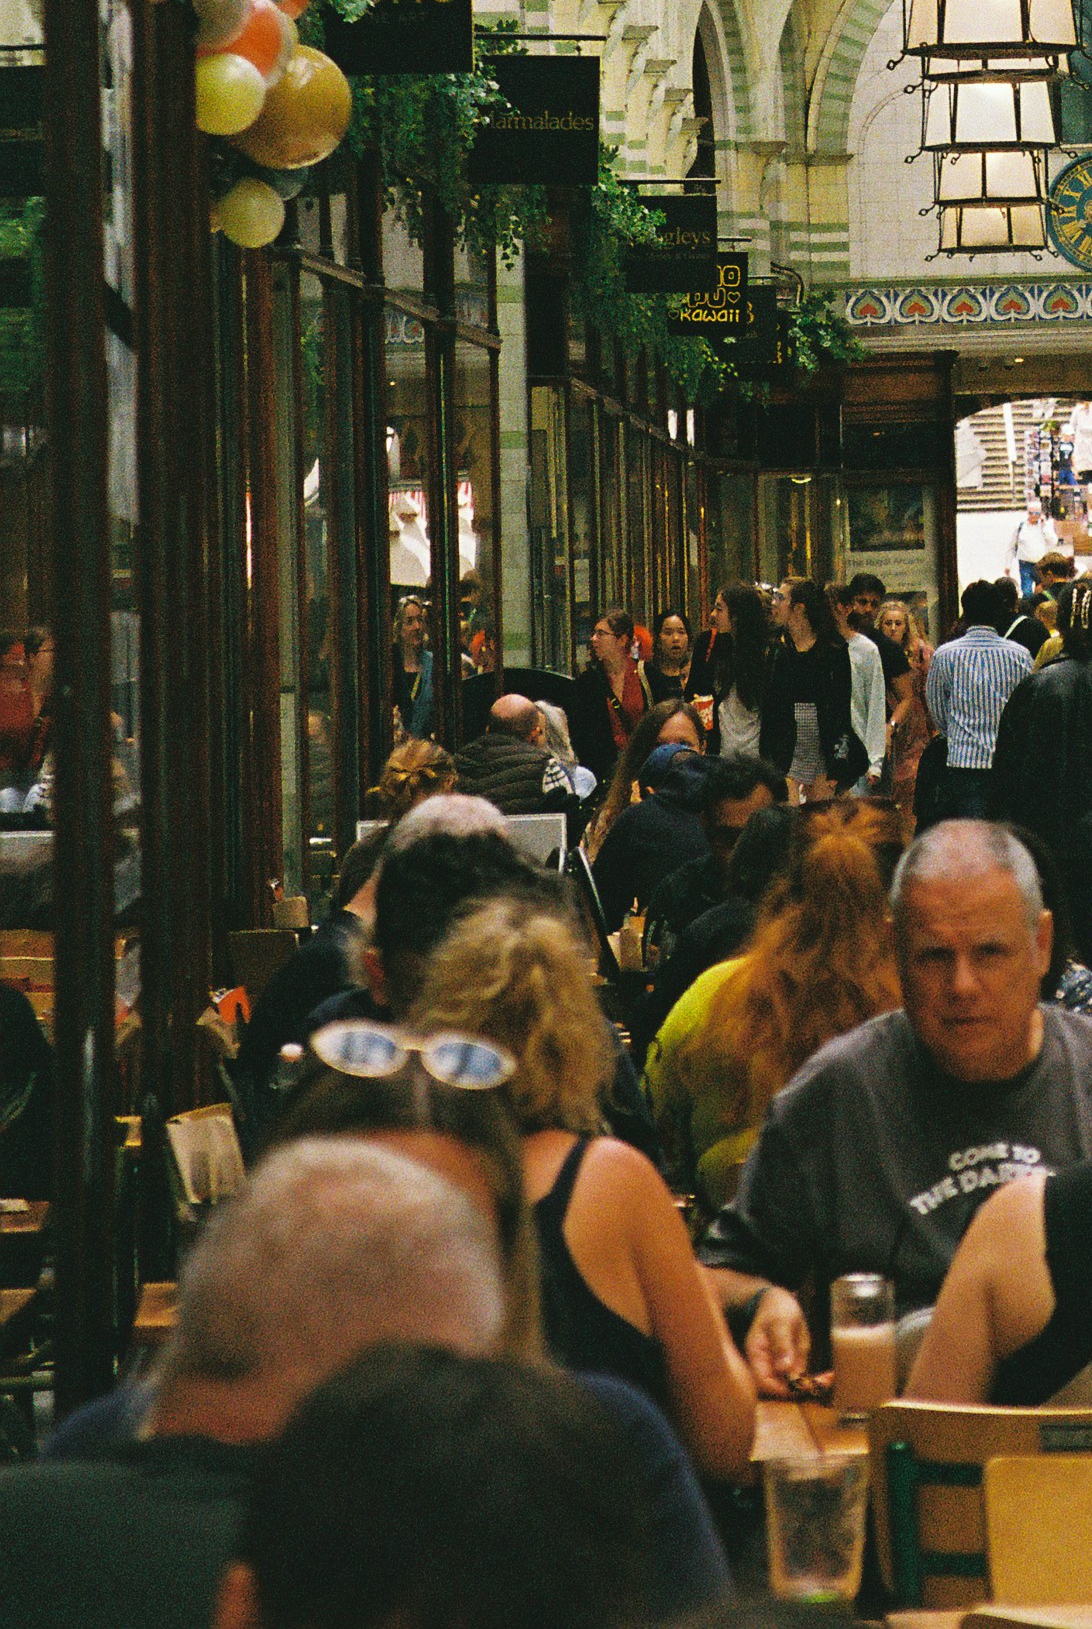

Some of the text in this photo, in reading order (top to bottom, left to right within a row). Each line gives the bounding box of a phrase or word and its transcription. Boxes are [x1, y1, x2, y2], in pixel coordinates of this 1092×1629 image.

[660, 227, 711, 249] gleys
[949, 1142, 1041, 1171] COME TO
[910, 1176, 958, 1215] THE
